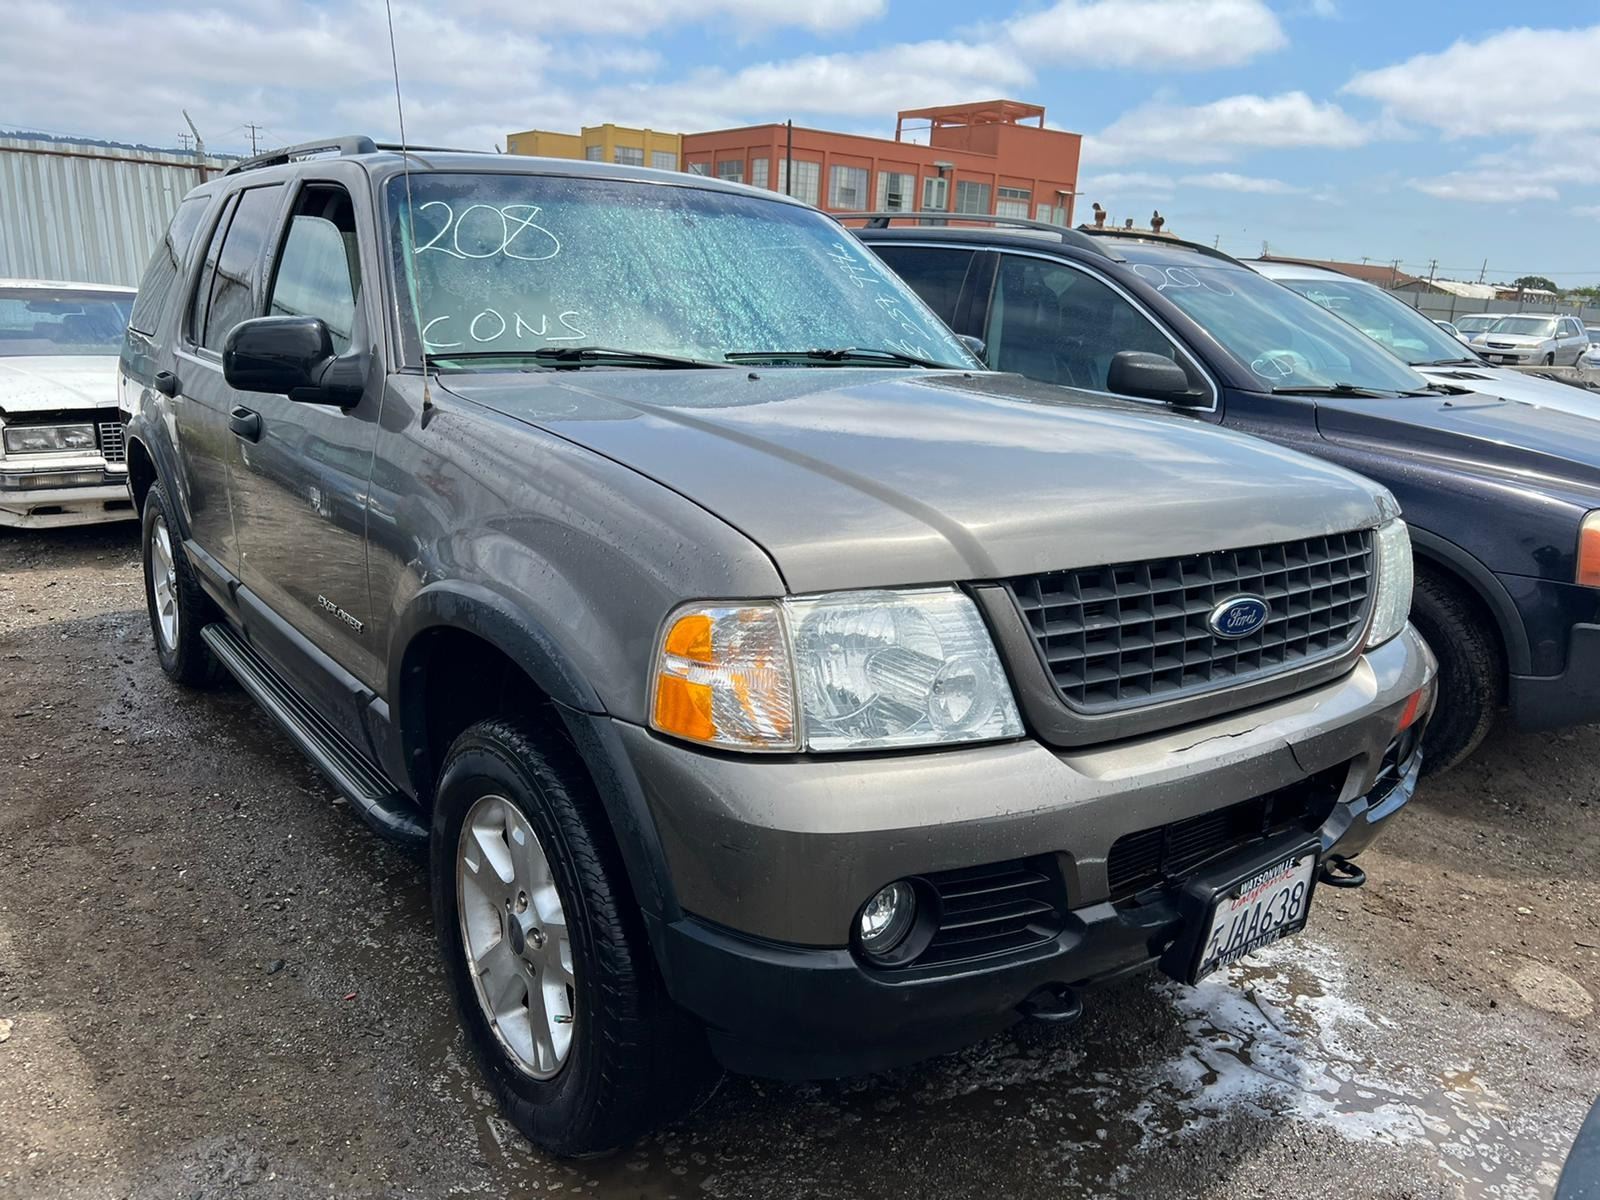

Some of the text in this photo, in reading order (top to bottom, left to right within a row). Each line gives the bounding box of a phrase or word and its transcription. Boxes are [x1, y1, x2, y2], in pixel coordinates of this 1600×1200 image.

[414, 201, 560, 261] 208
[422, 308, 587, 348] CONS
[1227, 606, 1257, 628] Ford
[1240, 857, 1296, 895] WATSONVILLE
[1203, 881, 1305, 965] 5JAA638
